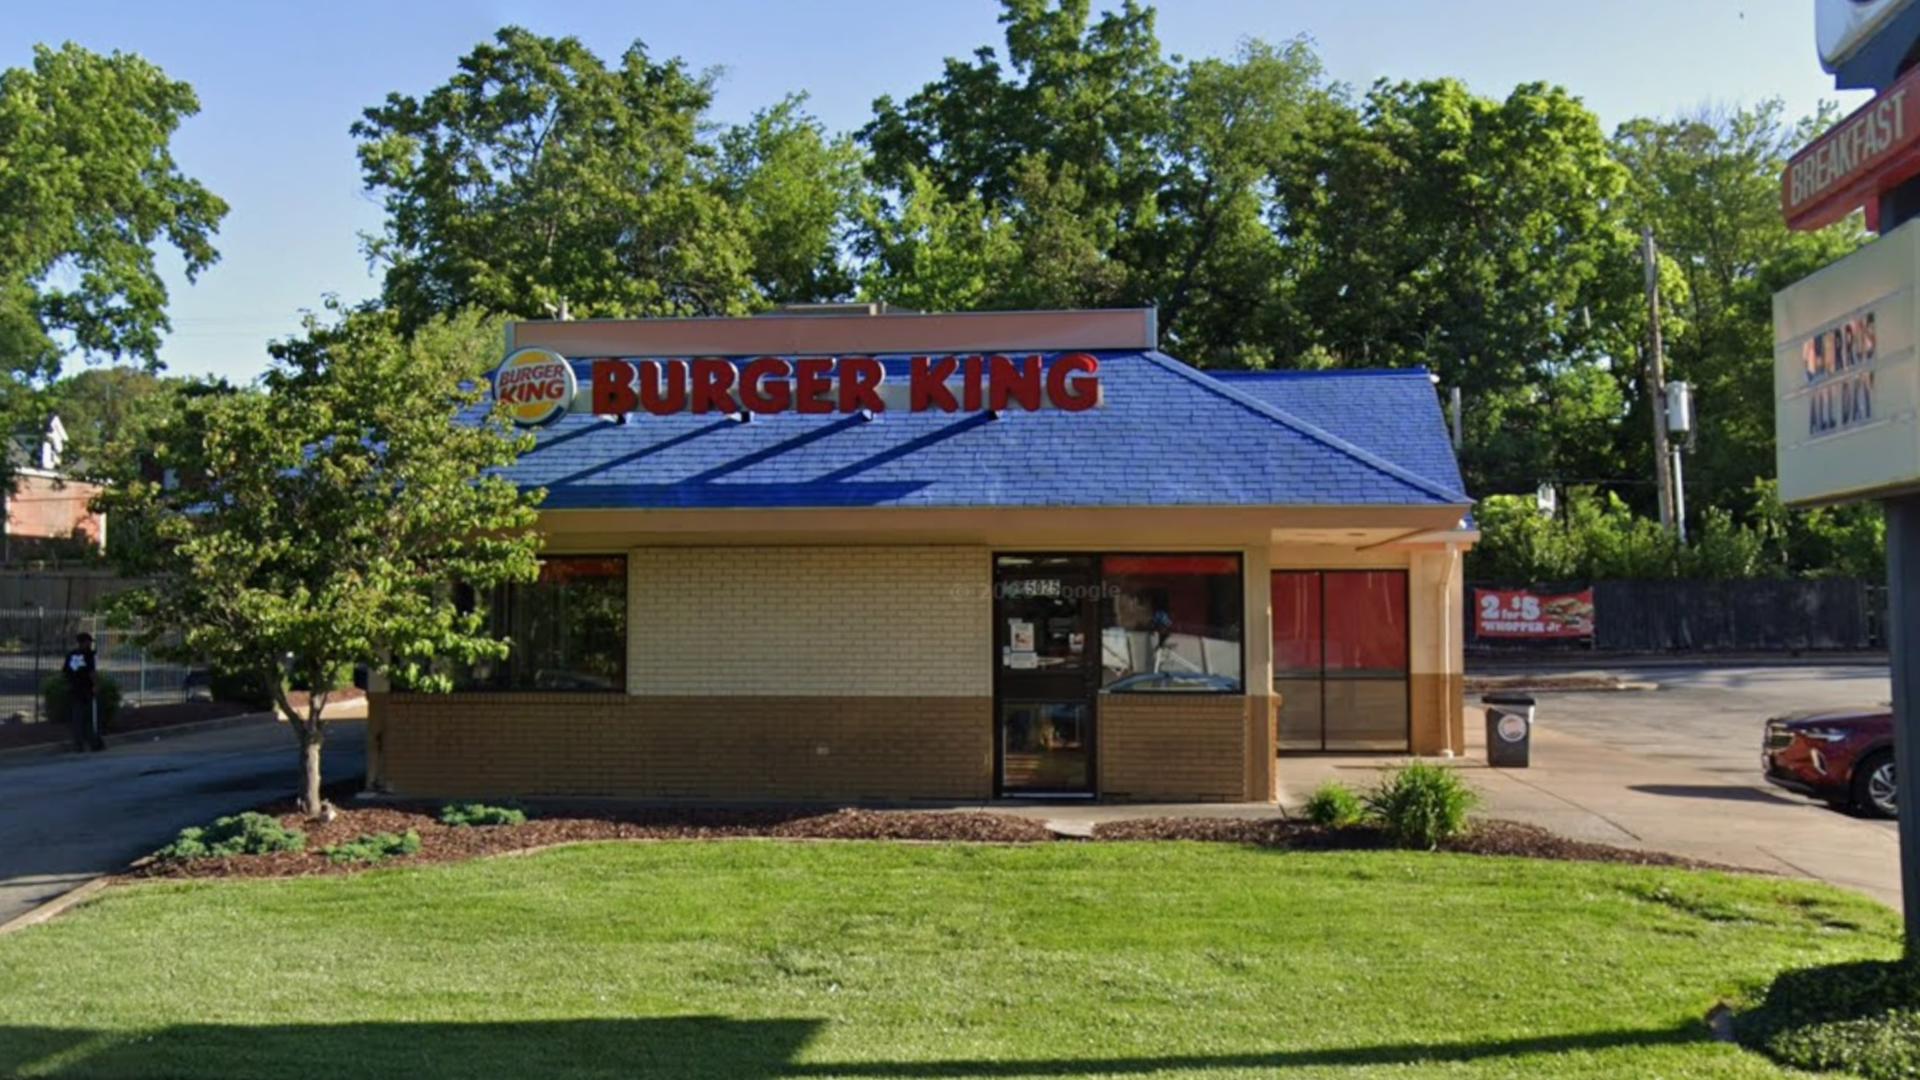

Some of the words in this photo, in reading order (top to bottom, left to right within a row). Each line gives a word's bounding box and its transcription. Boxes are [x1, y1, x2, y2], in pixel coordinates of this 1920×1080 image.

[1790, 89, 1906, 206] BREAKFAST
[1802, 312, 1875, 383] RROS
[500, 364, 564, 387] BURGER
[500, 380, 564, 405] KING
[592, 356, 885, 415] BURGER
[909, 353, 1100, 413] KING
[1809, 385, 1837, 435] ALL
[1842, 371, 1873, 425] DAY
[1481, 595, 1499, 619] 2
[1502, 609, 1520, 619] for
[1482, 621, 1544, 632] WHOPPER
